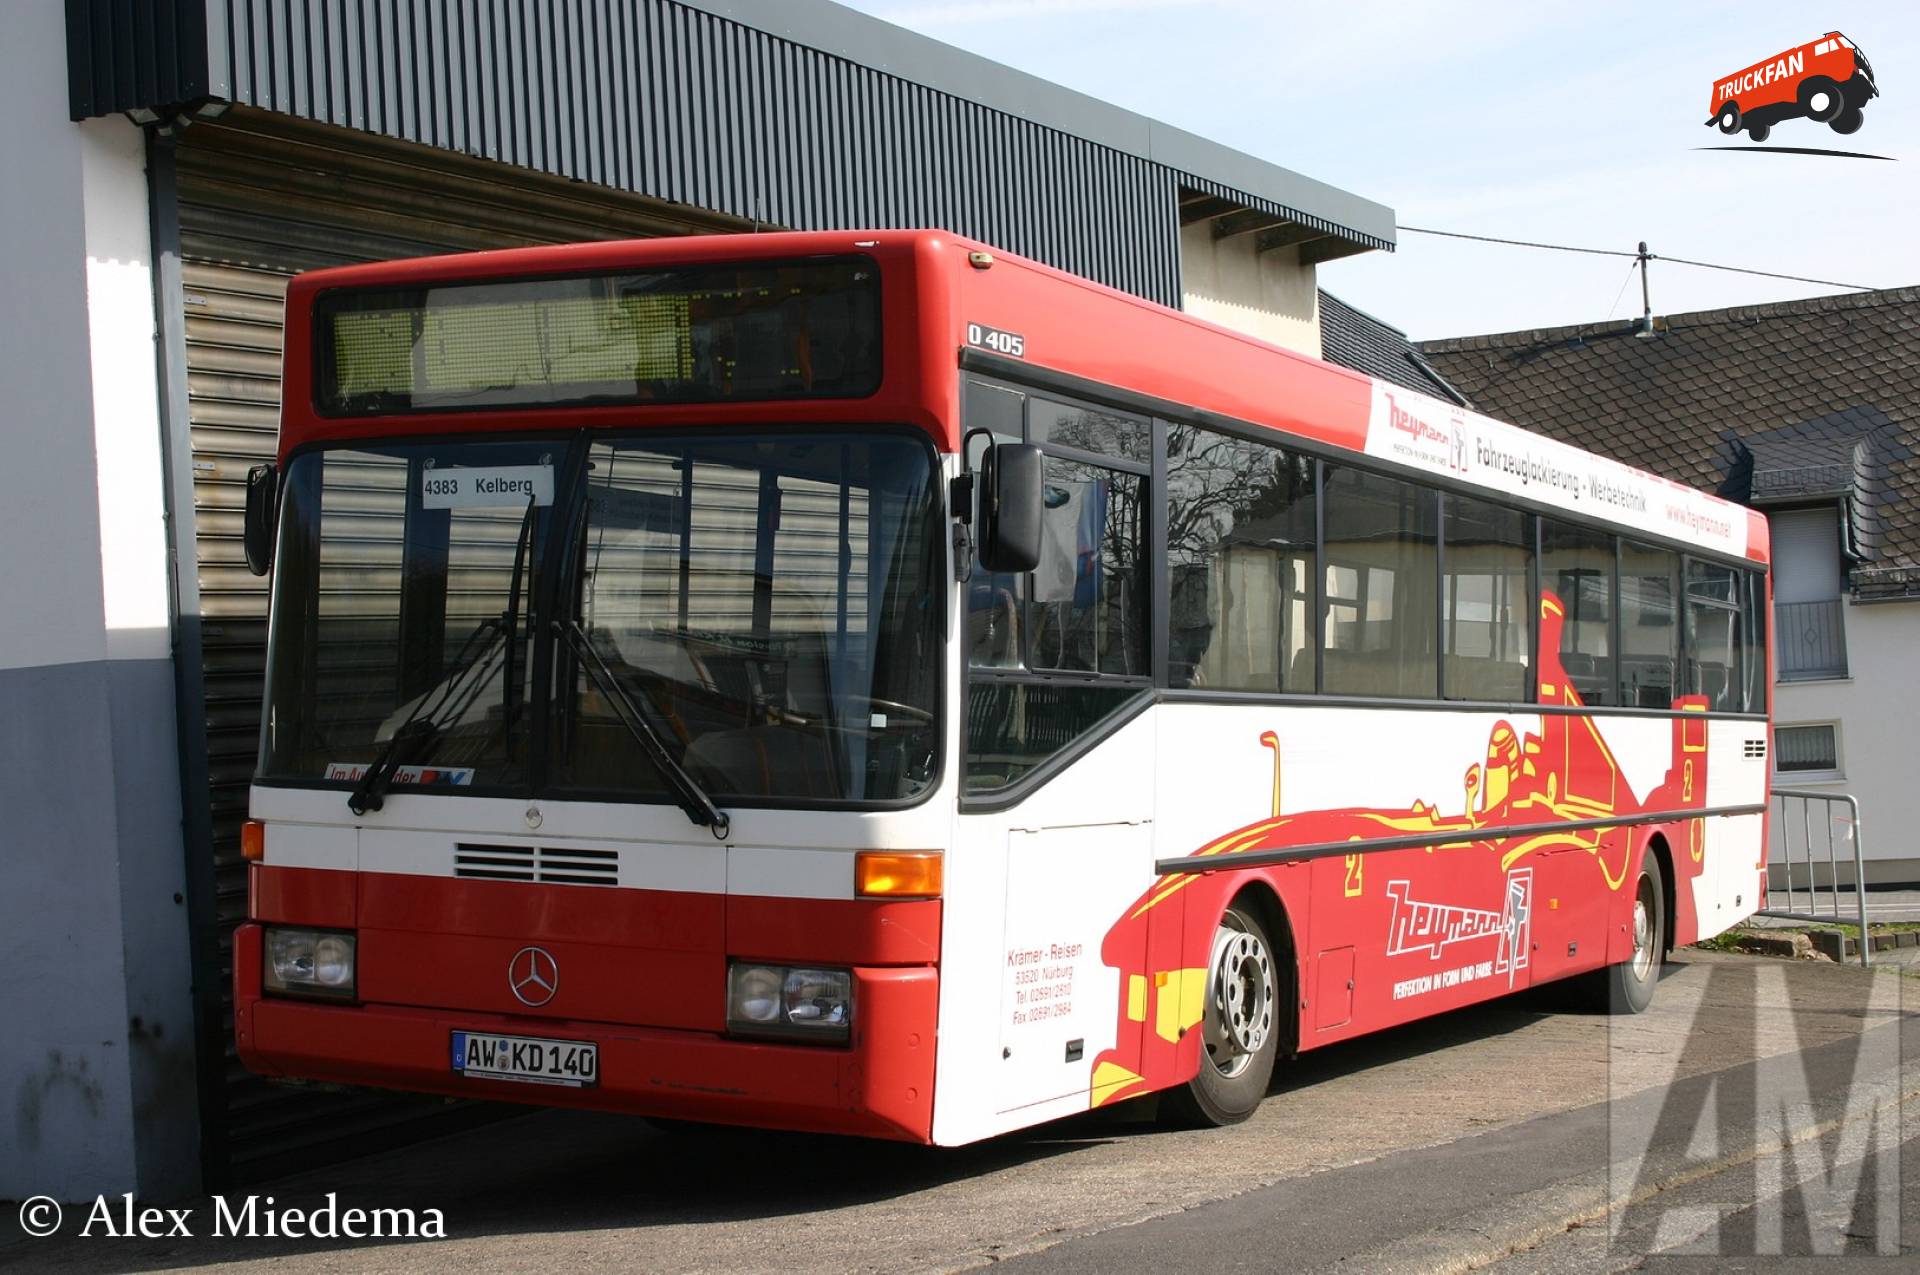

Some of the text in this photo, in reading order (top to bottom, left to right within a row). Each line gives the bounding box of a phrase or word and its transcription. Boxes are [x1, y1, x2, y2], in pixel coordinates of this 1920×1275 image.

[985, 331, 1024, 356] 405
[424, 477, 533, 496] 4383 Kelberg
[1476, 437, 1579, 500] Fahrzeuglackierung
[1588, 473, 1648, 512] Werbetechnik
[1683, 759, 1693, 802] 2
[1050, 942, 1082, 961] Reisen
[467, 1038, 497, 1068] AW
[512, 1042, 543, 1073] KD
[549, 1046, 595, 1077] 140
